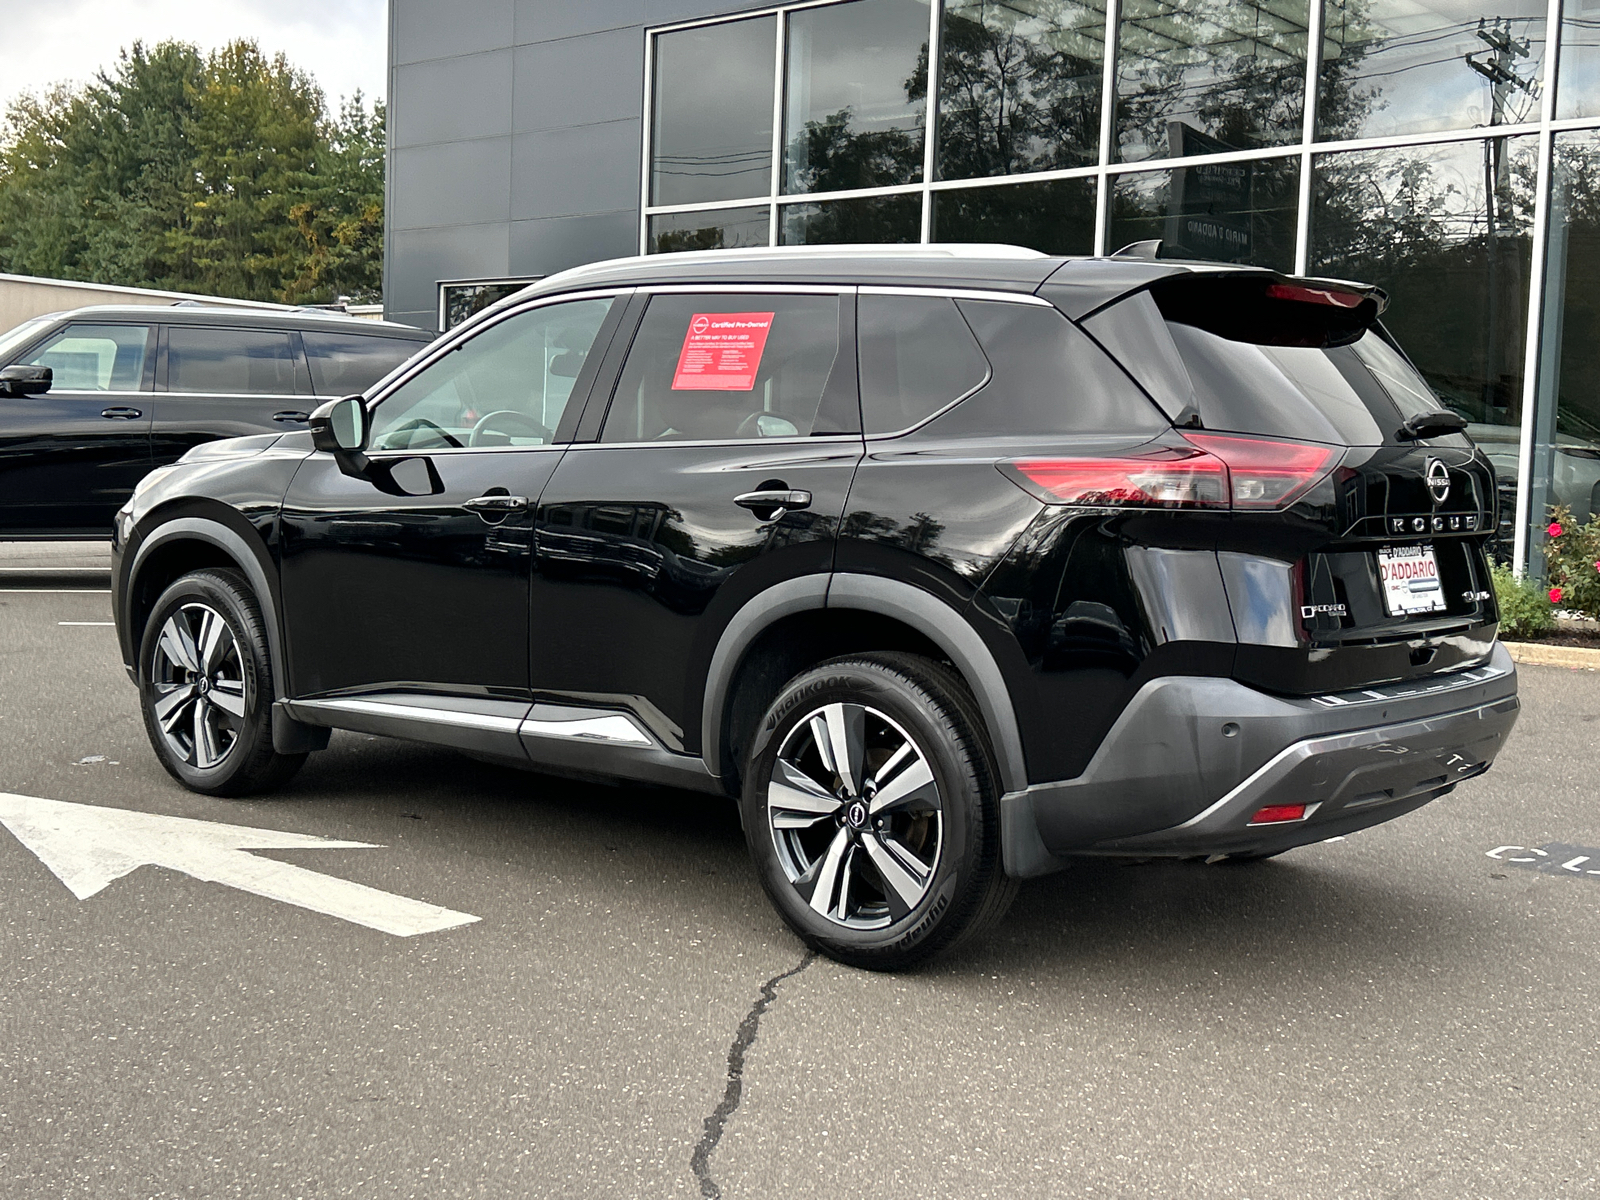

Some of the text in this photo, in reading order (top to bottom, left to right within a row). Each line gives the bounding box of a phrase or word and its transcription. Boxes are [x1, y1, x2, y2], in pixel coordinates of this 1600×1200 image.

[1393, 516, 1475, 532] ROGUE
[1393, 546, 1422, 556] D'ADDARIO
[1381, 560, 1436, 581] D'ADDARIO
